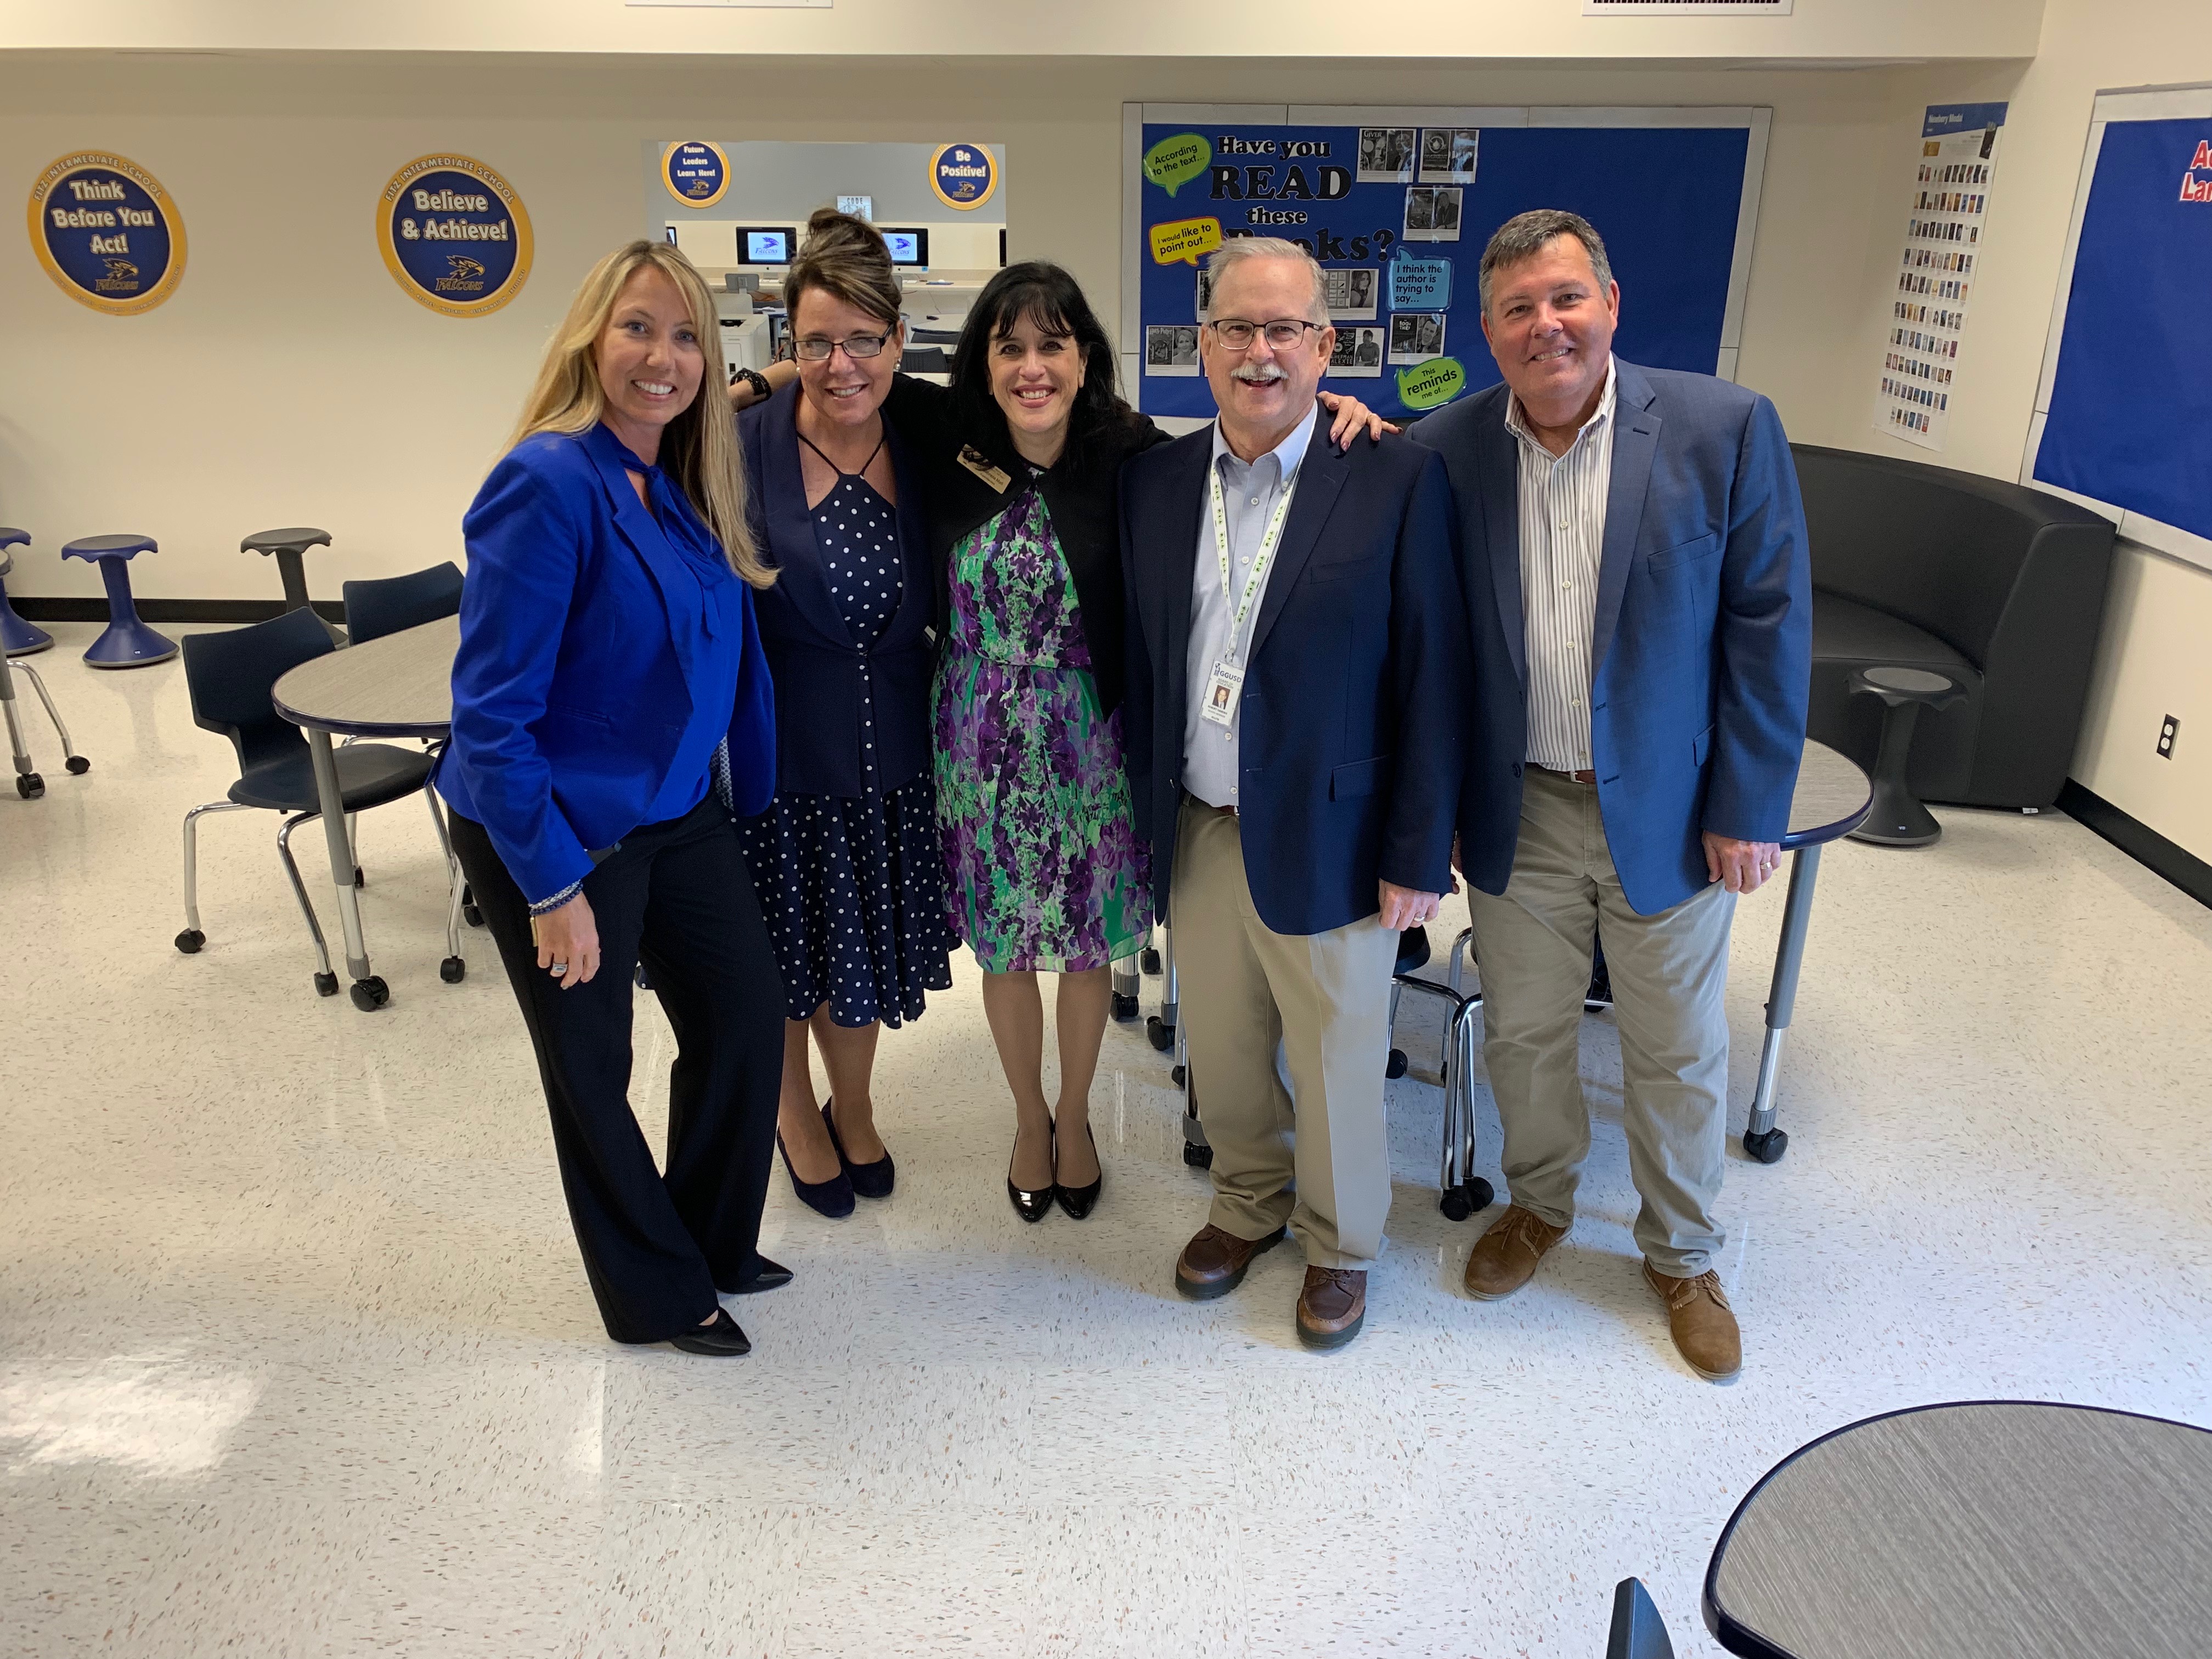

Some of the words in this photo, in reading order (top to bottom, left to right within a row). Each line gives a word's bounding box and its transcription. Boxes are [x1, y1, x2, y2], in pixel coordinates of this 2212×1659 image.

[955, 149, 972, 162] Be
[1155, 144, 1198, 165] According
[1217, 136, 1276, 154] Have
[1278, 140, 1331, 161] you
[940, 165, 986, 177] Positive!
[1164, 161, 1178, 172] the
[1180, 154, 1205, 167] text...
[33, 179, 49, 201] FITZ
[46, 154, 119, 180] INTERMEDIATE
[122, 162, 163, 199] SCHOOL
[385, 179, 402, 202] FITZ
[399, 156, 475, 182] INTERMEDIATE
[476, 166, 515, 204] SCHOOL
[1209, 165, 1352, 201] READ
[69, 180, 126, 200] Think
[412, 189, 488, 211] Believe
[52, 208, 116, 228] Before
[116, 206, 155, 226] You
[1245, 206, 1308, 225] these
[401, 218, 420, 240] &
[424, 218, 508, 240] Achieve!
[1161, 233, 1181, 243] would
[1181, 227, 1199, 238] like
[1201, 224, 1211, 233] to
[90, 233, 129, 253] Act!
[1160, 241, 1184, 257] point
[1187, 236, 1211, 247] out...
[1225, 228, 1395, 262] oks?
[1402, 264, 1425, 273] think
[1427, 264, 1443, 273] the
[95, 279, 138, 291] FALCONS
[435, 278, 484, 291] FALCONS
[1396, 274, 1427, 283] author
[1429, 274, 1436, 283] is
[1395, 284, 1422, 295] trying
[1395, 296, 1419, 304] say...
[1421, 368, 1436, 377] This
[1407, 369, 1458, 396] reminds
[1434, 386, 1449, 394] of...
[1220, 670, 1242, 683] GGUSD
